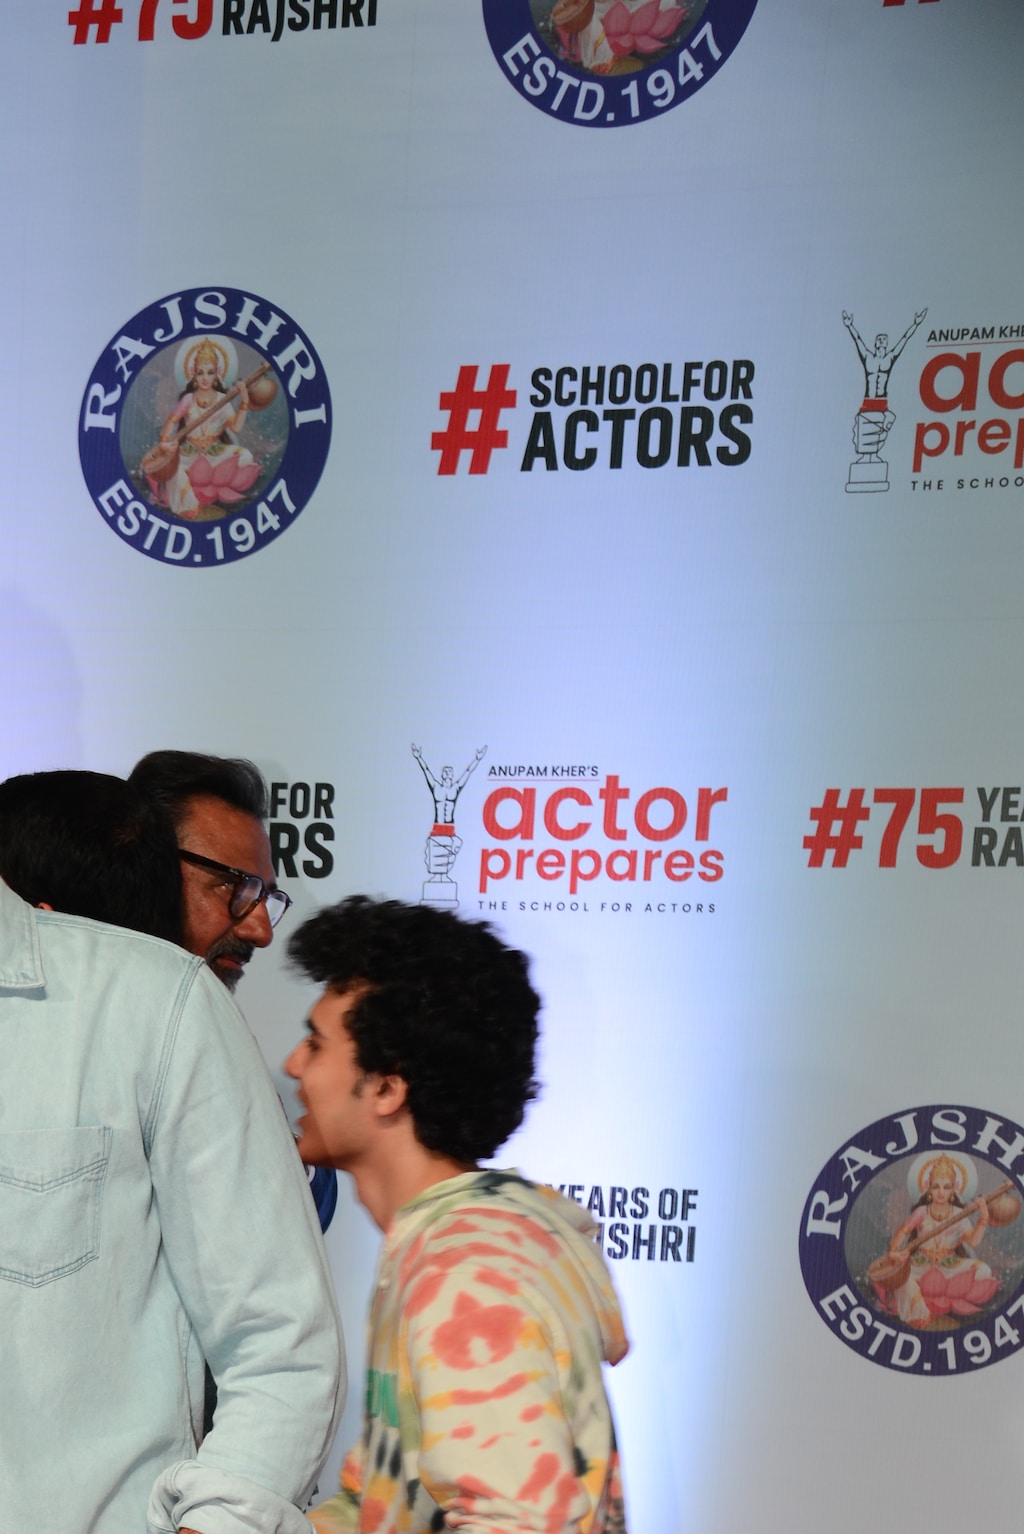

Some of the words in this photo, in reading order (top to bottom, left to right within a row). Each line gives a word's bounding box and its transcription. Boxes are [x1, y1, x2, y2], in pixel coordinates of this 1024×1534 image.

[502, 21, 722, 121] ESTD.1947
[84, 291, 327, 433] RAJSHRI
[927, 326, 995, 342] ANUPAM
[520, 403, 754, 473] ACTORS
[911, 480, 944, 491] THE
[98, 478, 297, 562] ESTD.1947
[488, 766, 548, 778] ANUPAM
[551, 766, 599, 778] KHER'S
[482, 775, 728, 842] actor
[803, 788, 964, 870] #75
[479, 848, 724, 895] prepares
[478, 901, 508, 911] THE
[519, 901, 589, 912] SCHOOL
[601, 902, 633, 912] FOR
[645, 902, 716, 913] ACTORS
[806, 1109, 1024, 1239] RAJSH
[658, 1188, 699, 1221] OF
[600, 1222, 696, 1263] SHRI
